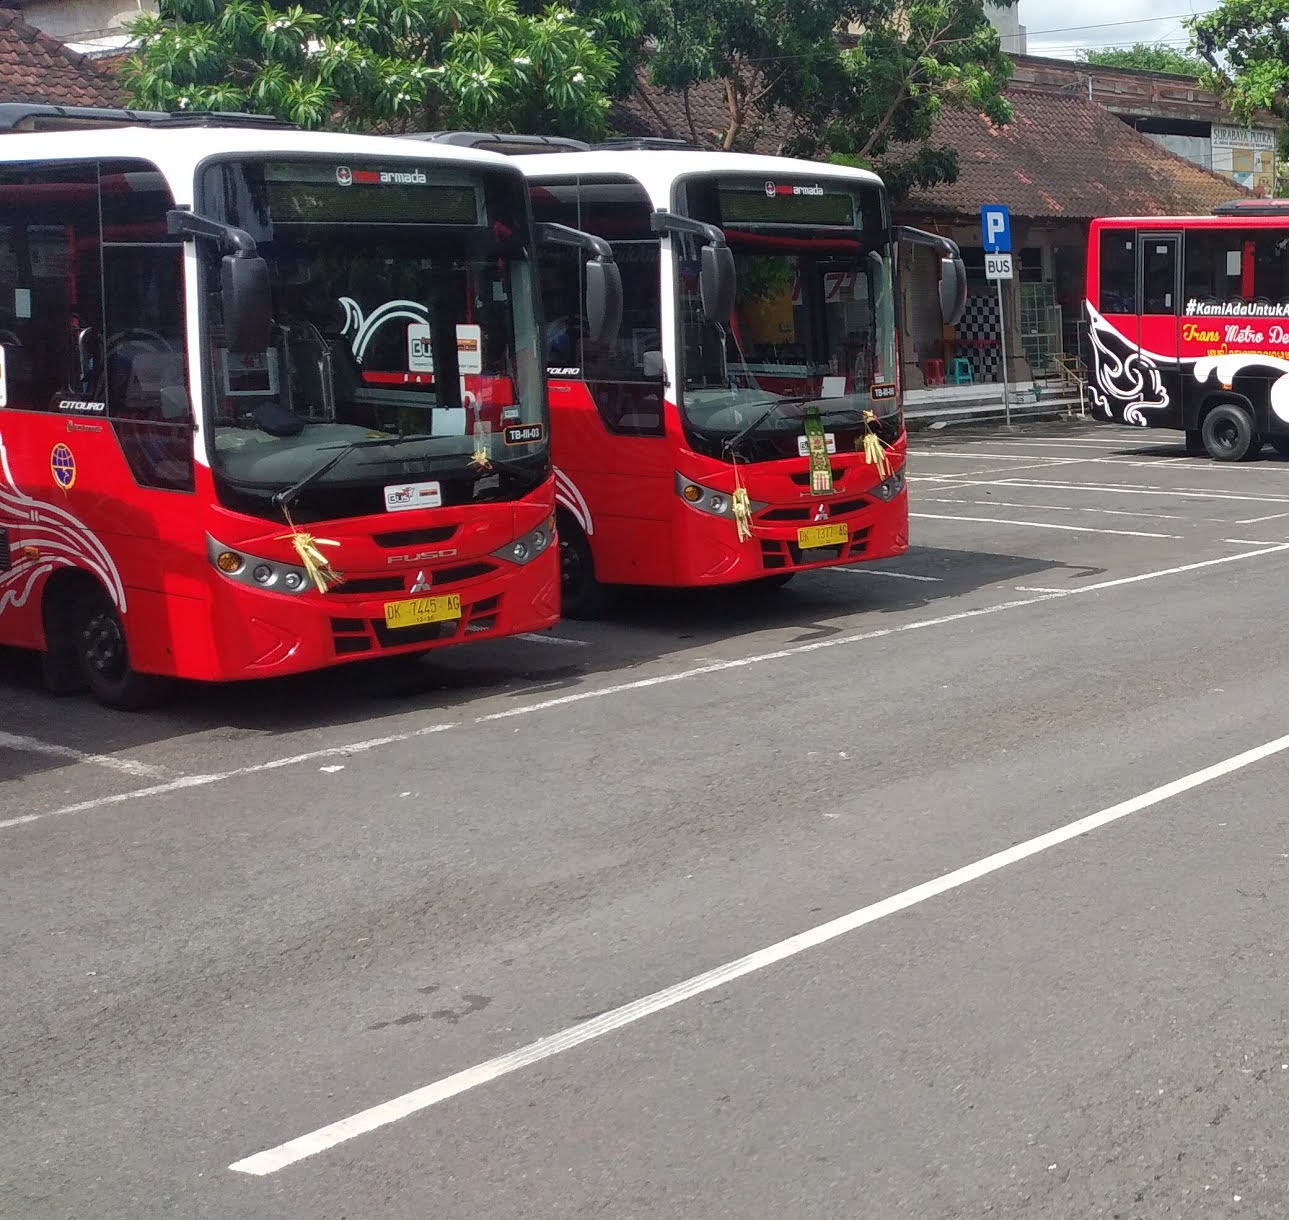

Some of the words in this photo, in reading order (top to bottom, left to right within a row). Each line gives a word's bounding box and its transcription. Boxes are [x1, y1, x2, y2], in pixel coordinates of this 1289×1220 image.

[1213, 128, 1248, 141] SURABAYA
[1250, 131, 1272, 143] PUTRA
[380, 168, 427, 184] armada
[986, 211, 1005, 244] P
[987, 260, 1010, 274] BUS
[1182, 323, 1220, 342] Trans
[1224, 324, 1265, 343] Metro
[59, 400, 105, 411] CITOURO
[509, 427, 540, 441] TB-III-03
[387, 548, 458, 565] FUSO
[387, 603, 400, 620] DK
[410, 598, 437, 617] 7445
[447, 596, 460, 611] AG
